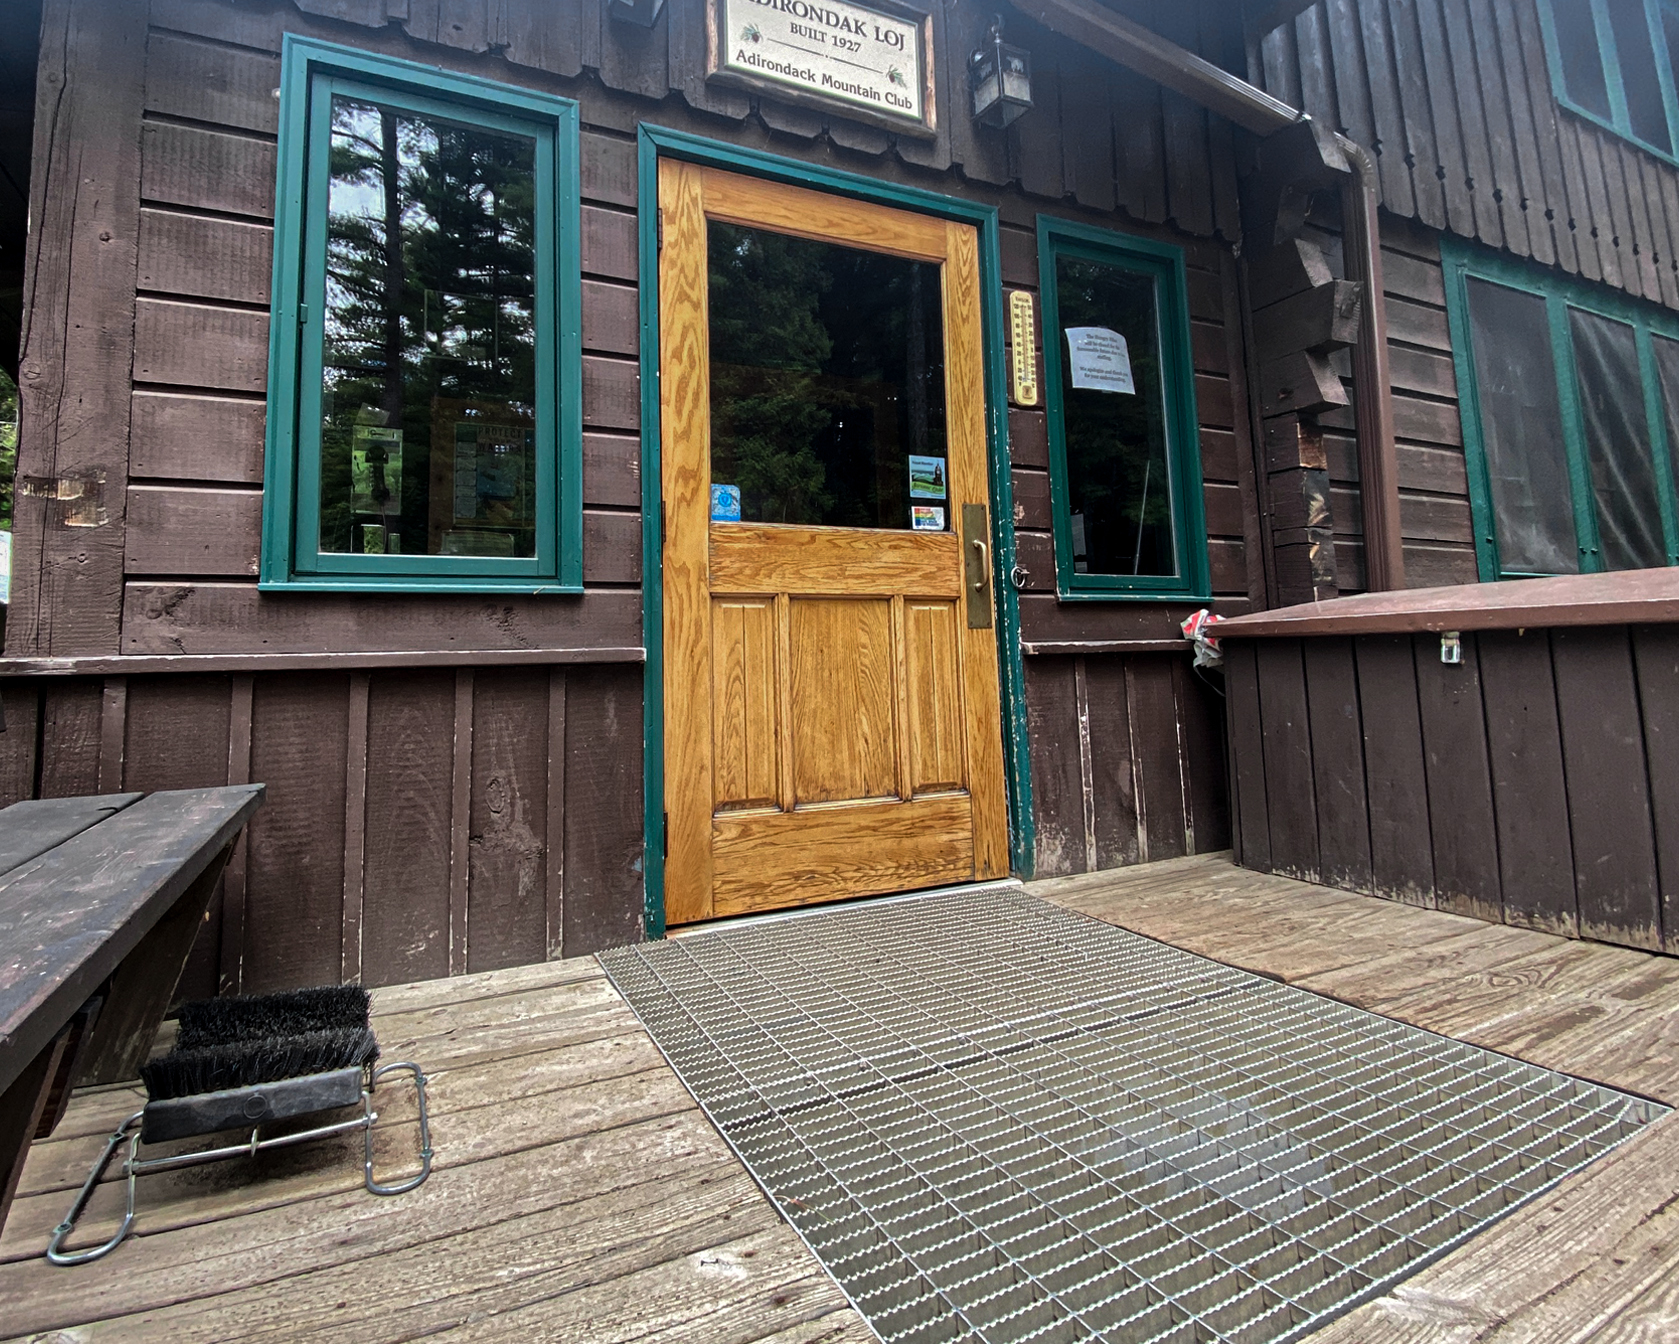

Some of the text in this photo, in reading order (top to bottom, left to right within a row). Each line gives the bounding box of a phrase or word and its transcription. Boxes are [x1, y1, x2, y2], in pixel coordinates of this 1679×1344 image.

[749, 0, 905, 51] IRONDAK LOJ
[790, 22, 861, 53] BUILT 1927
[736, 49, 912, 110] Adirondack Mountain Club
